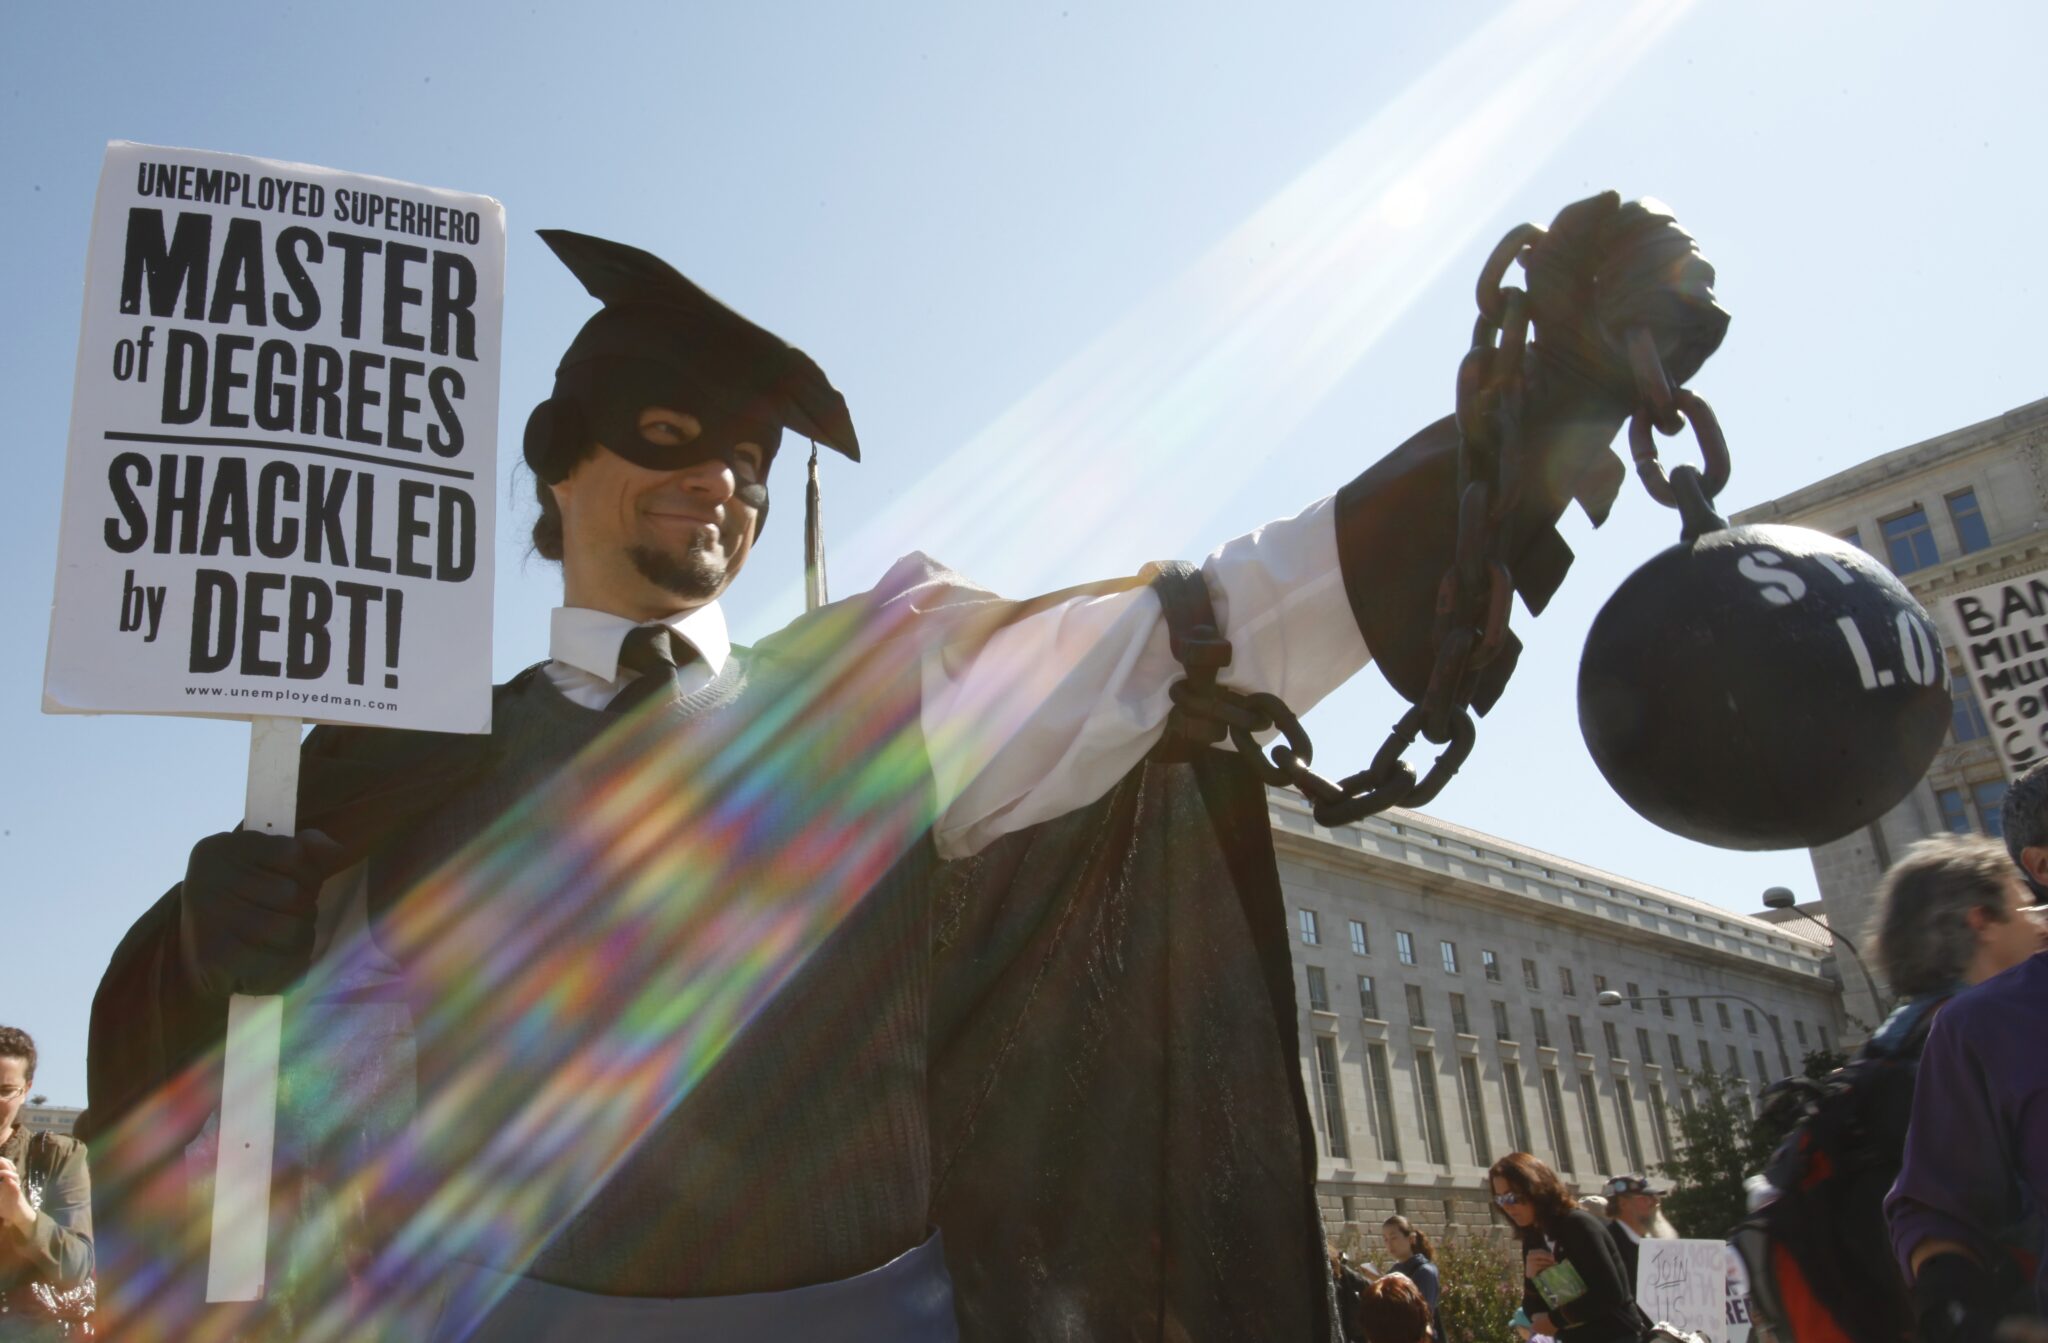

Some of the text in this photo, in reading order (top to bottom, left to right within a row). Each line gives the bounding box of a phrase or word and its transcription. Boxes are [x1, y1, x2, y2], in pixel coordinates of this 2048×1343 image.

[137, 162, 480, 246] UNEMPLOYED SUPERHERO
[119, 207, 479, 362] MASTER
[112, 326, 466, 459] of DEGREES
[103, 451, 477, 583] SHACKLED
[119, 568, 404, 690] by DEBT!
[1969, 623, 2048, 670] MIL
[185, 686, 398, 711] www.unemployedman.com
[1651, 1249, 1689, 1285] JOIN
[1656, 1295, 1688, 1328] US
